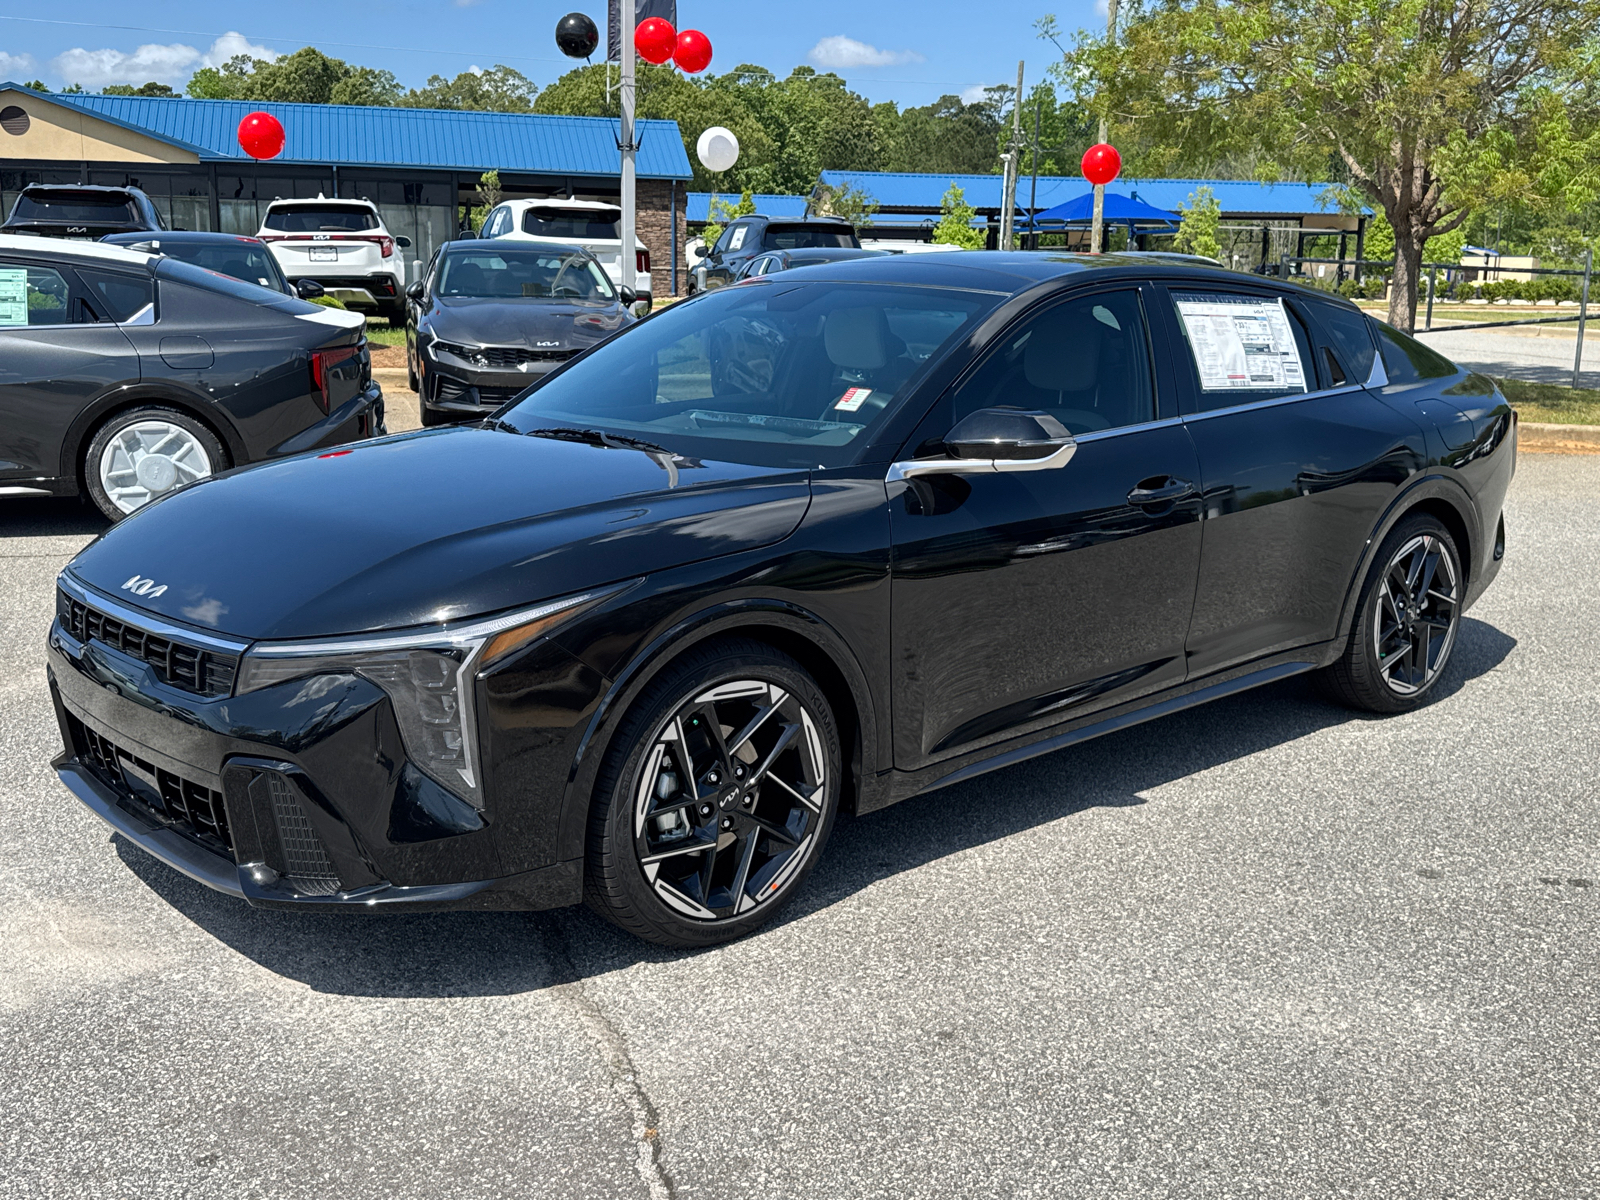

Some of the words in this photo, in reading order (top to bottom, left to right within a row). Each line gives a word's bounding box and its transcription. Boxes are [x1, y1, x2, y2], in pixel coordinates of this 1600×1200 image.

[121, 575, 168, 599] KIA
[811, 693, 837, 754] KUMHO
[719, 787, 740, 808] KIA
